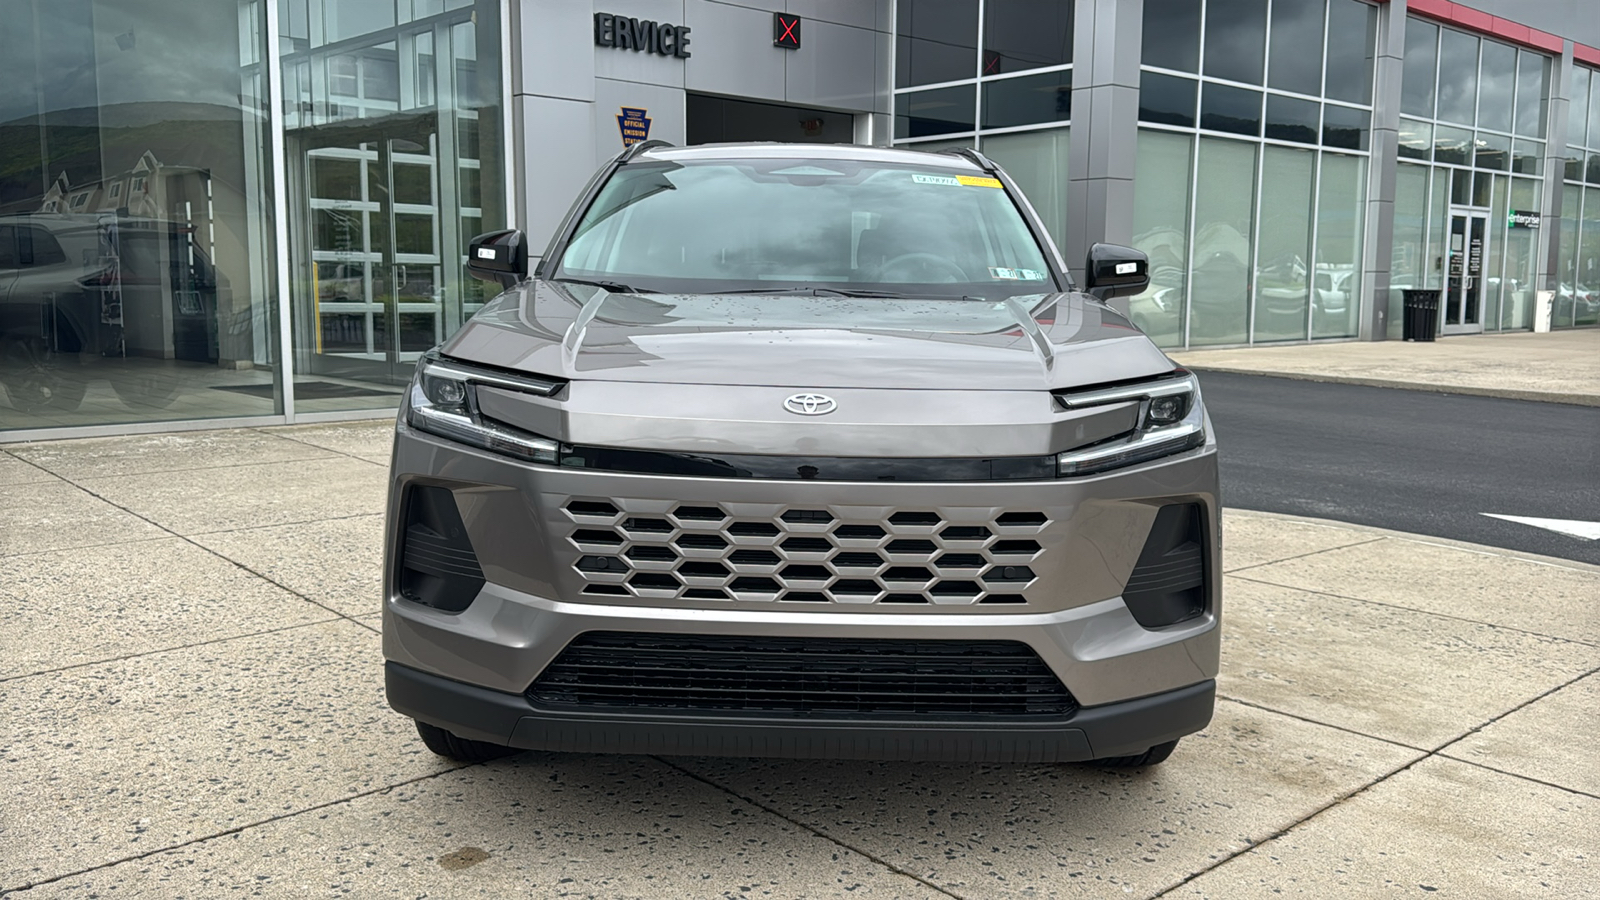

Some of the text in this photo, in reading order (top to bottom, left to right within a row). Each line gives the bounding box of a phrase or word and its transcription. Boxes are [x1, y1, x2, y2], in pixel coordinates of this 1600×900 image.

[594, 12, 691, 58] ERVICE
[624, 120, 645, 128] OFFICIAL
[624, 129, 646, 137] EMISSION
[1509, 213, 1540, 226] enterprise
